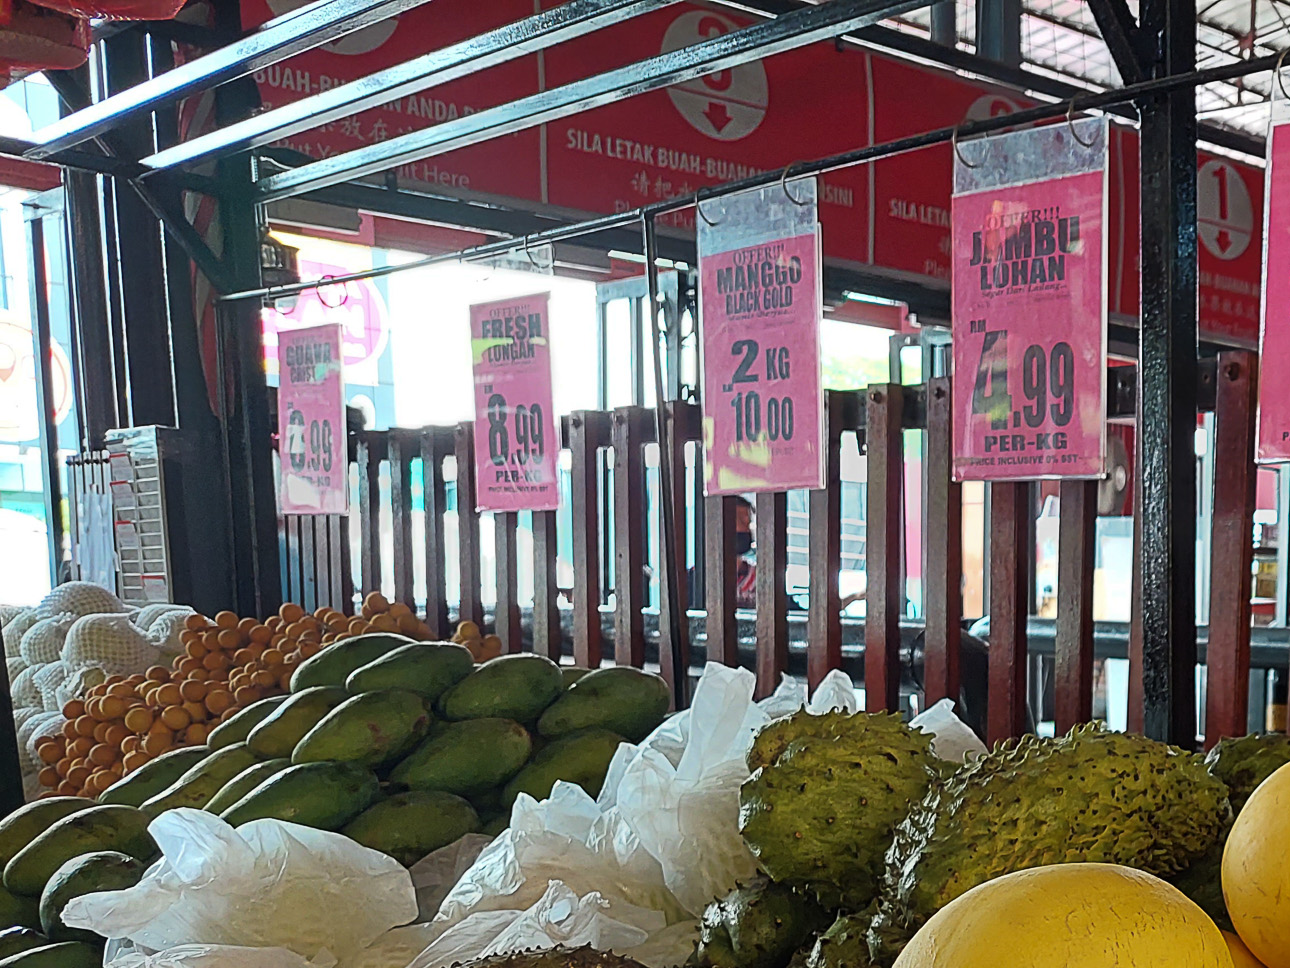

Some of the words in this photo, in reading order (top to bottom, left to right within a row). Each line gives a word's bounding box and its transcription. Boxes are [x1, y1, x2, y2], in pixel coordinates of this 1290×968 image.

[566, 128, 602, 154] SILA
[607, 137, 655, 166] LETAK
[920, 204, 951, 227] LETA
[717, 255, 802, 294] MANGGO
[980, 255, 1065, 291] LOHAN
[726, 291, 762, 316] BLACK
[763, 285, 793, 311] GOLD
[482, 312, 542, 340] FRESH
[731, 339, 759, 384] 2
[766, 346, 790, 381] KG
[972, 330, 1075, 430] 4.99
[488, 393, 545, 467] 8.99
[984, 432, 1068, 453] PER-KG
